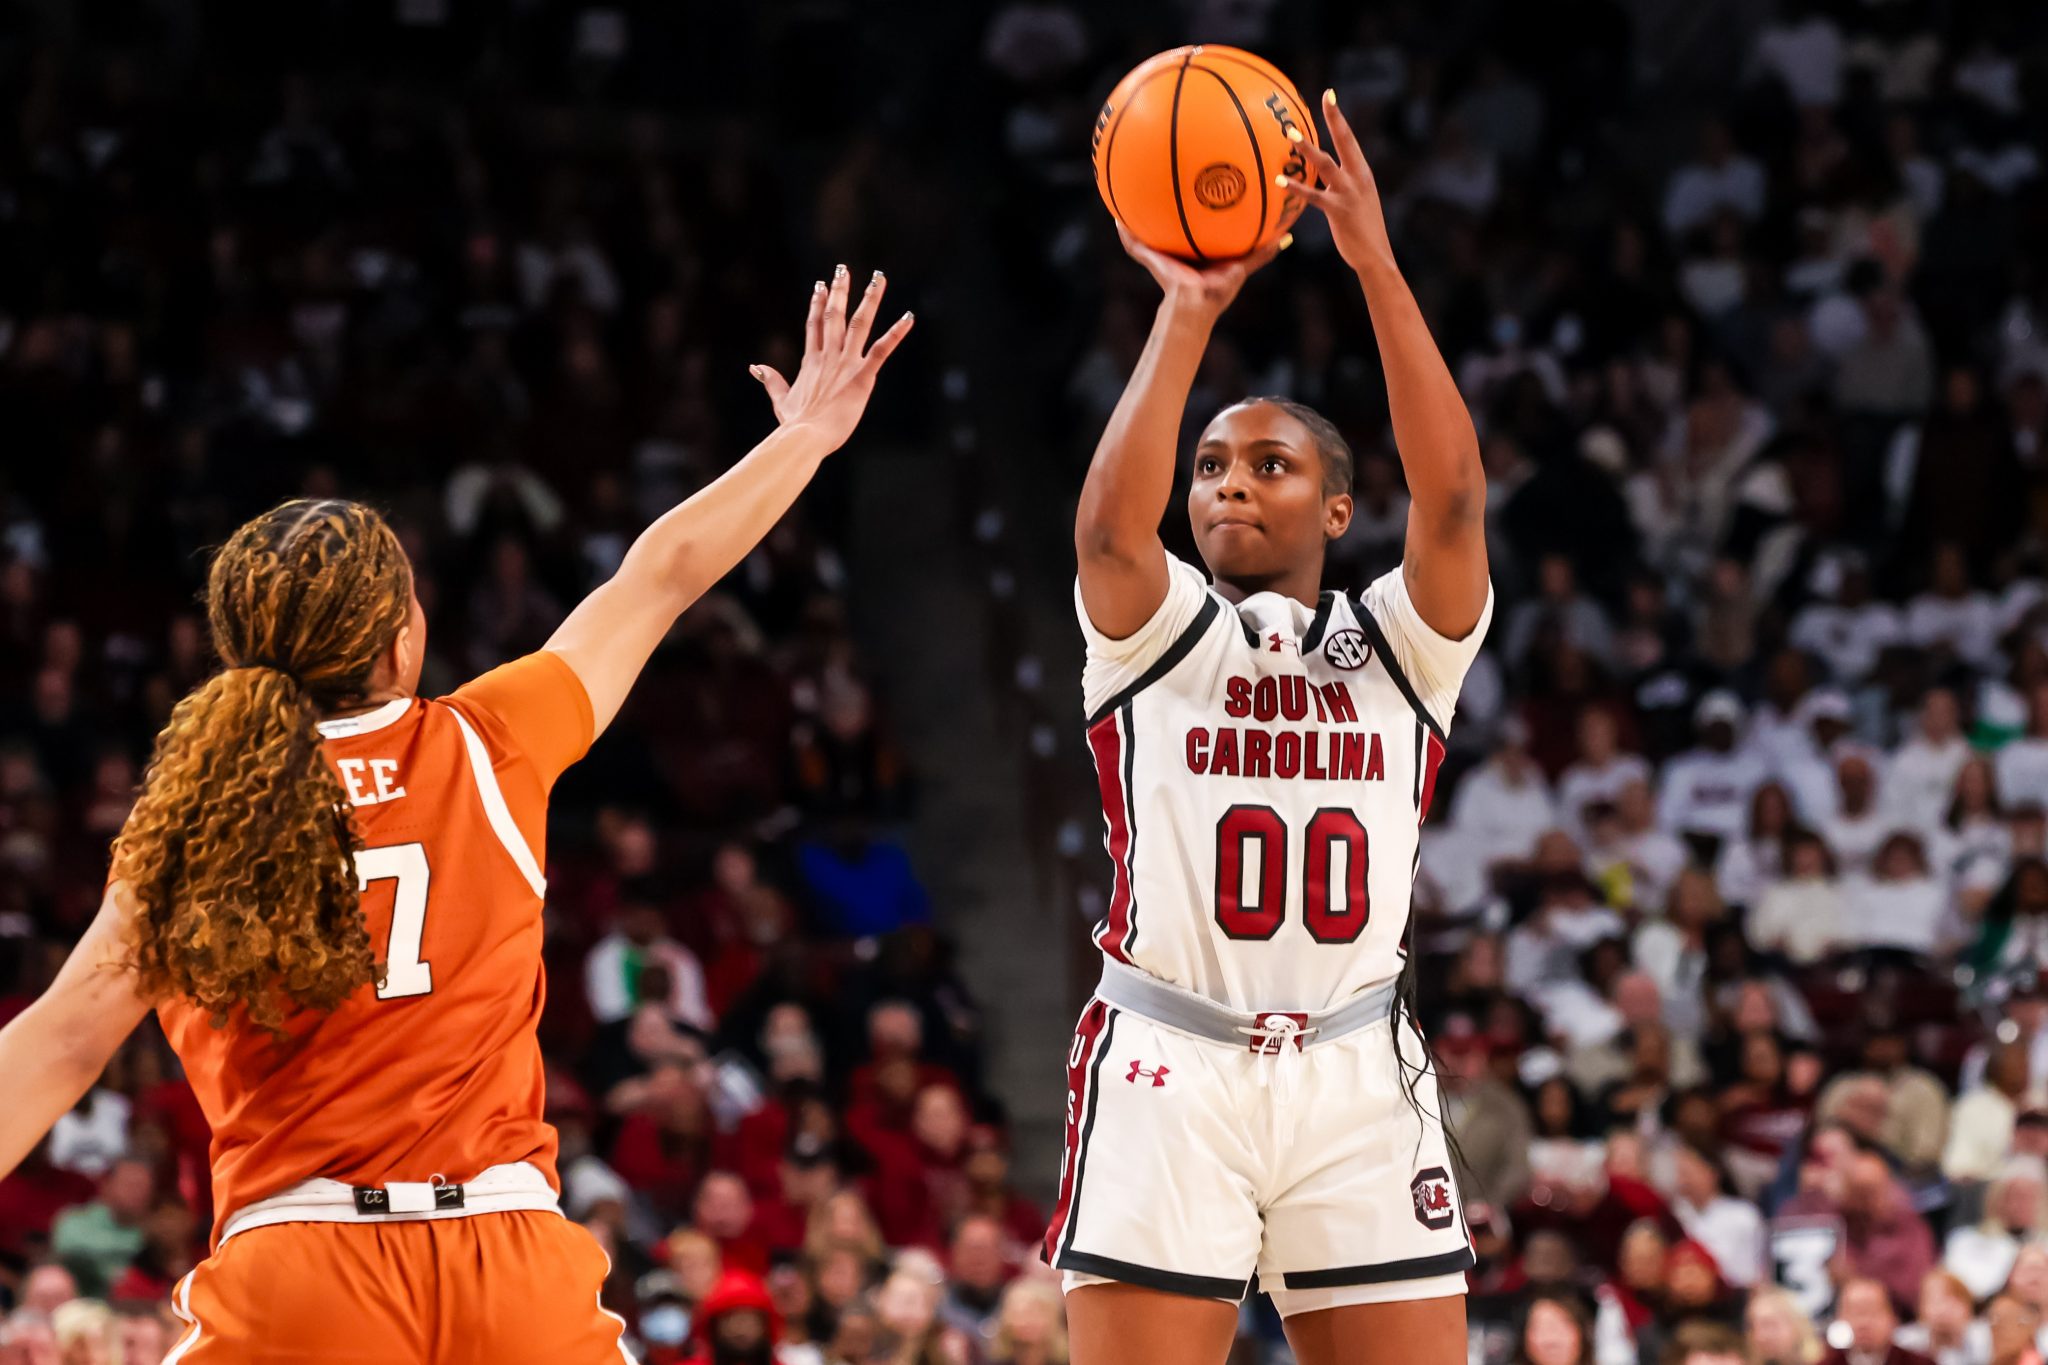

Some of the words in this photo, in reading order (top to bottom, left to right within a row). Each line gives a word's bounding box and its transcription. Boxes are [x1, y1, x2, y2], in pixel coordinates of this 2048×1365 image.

[1326, 629, 1370, 670] SEC
[1224, 674, 1359, 724] SOUTH
[1186, 727, 1385, 782] CAROLINA
[334, 758, 407, 812] EE
[1214, 804, 1371, 945] 00
[349, 841, 433, 1000] 7
